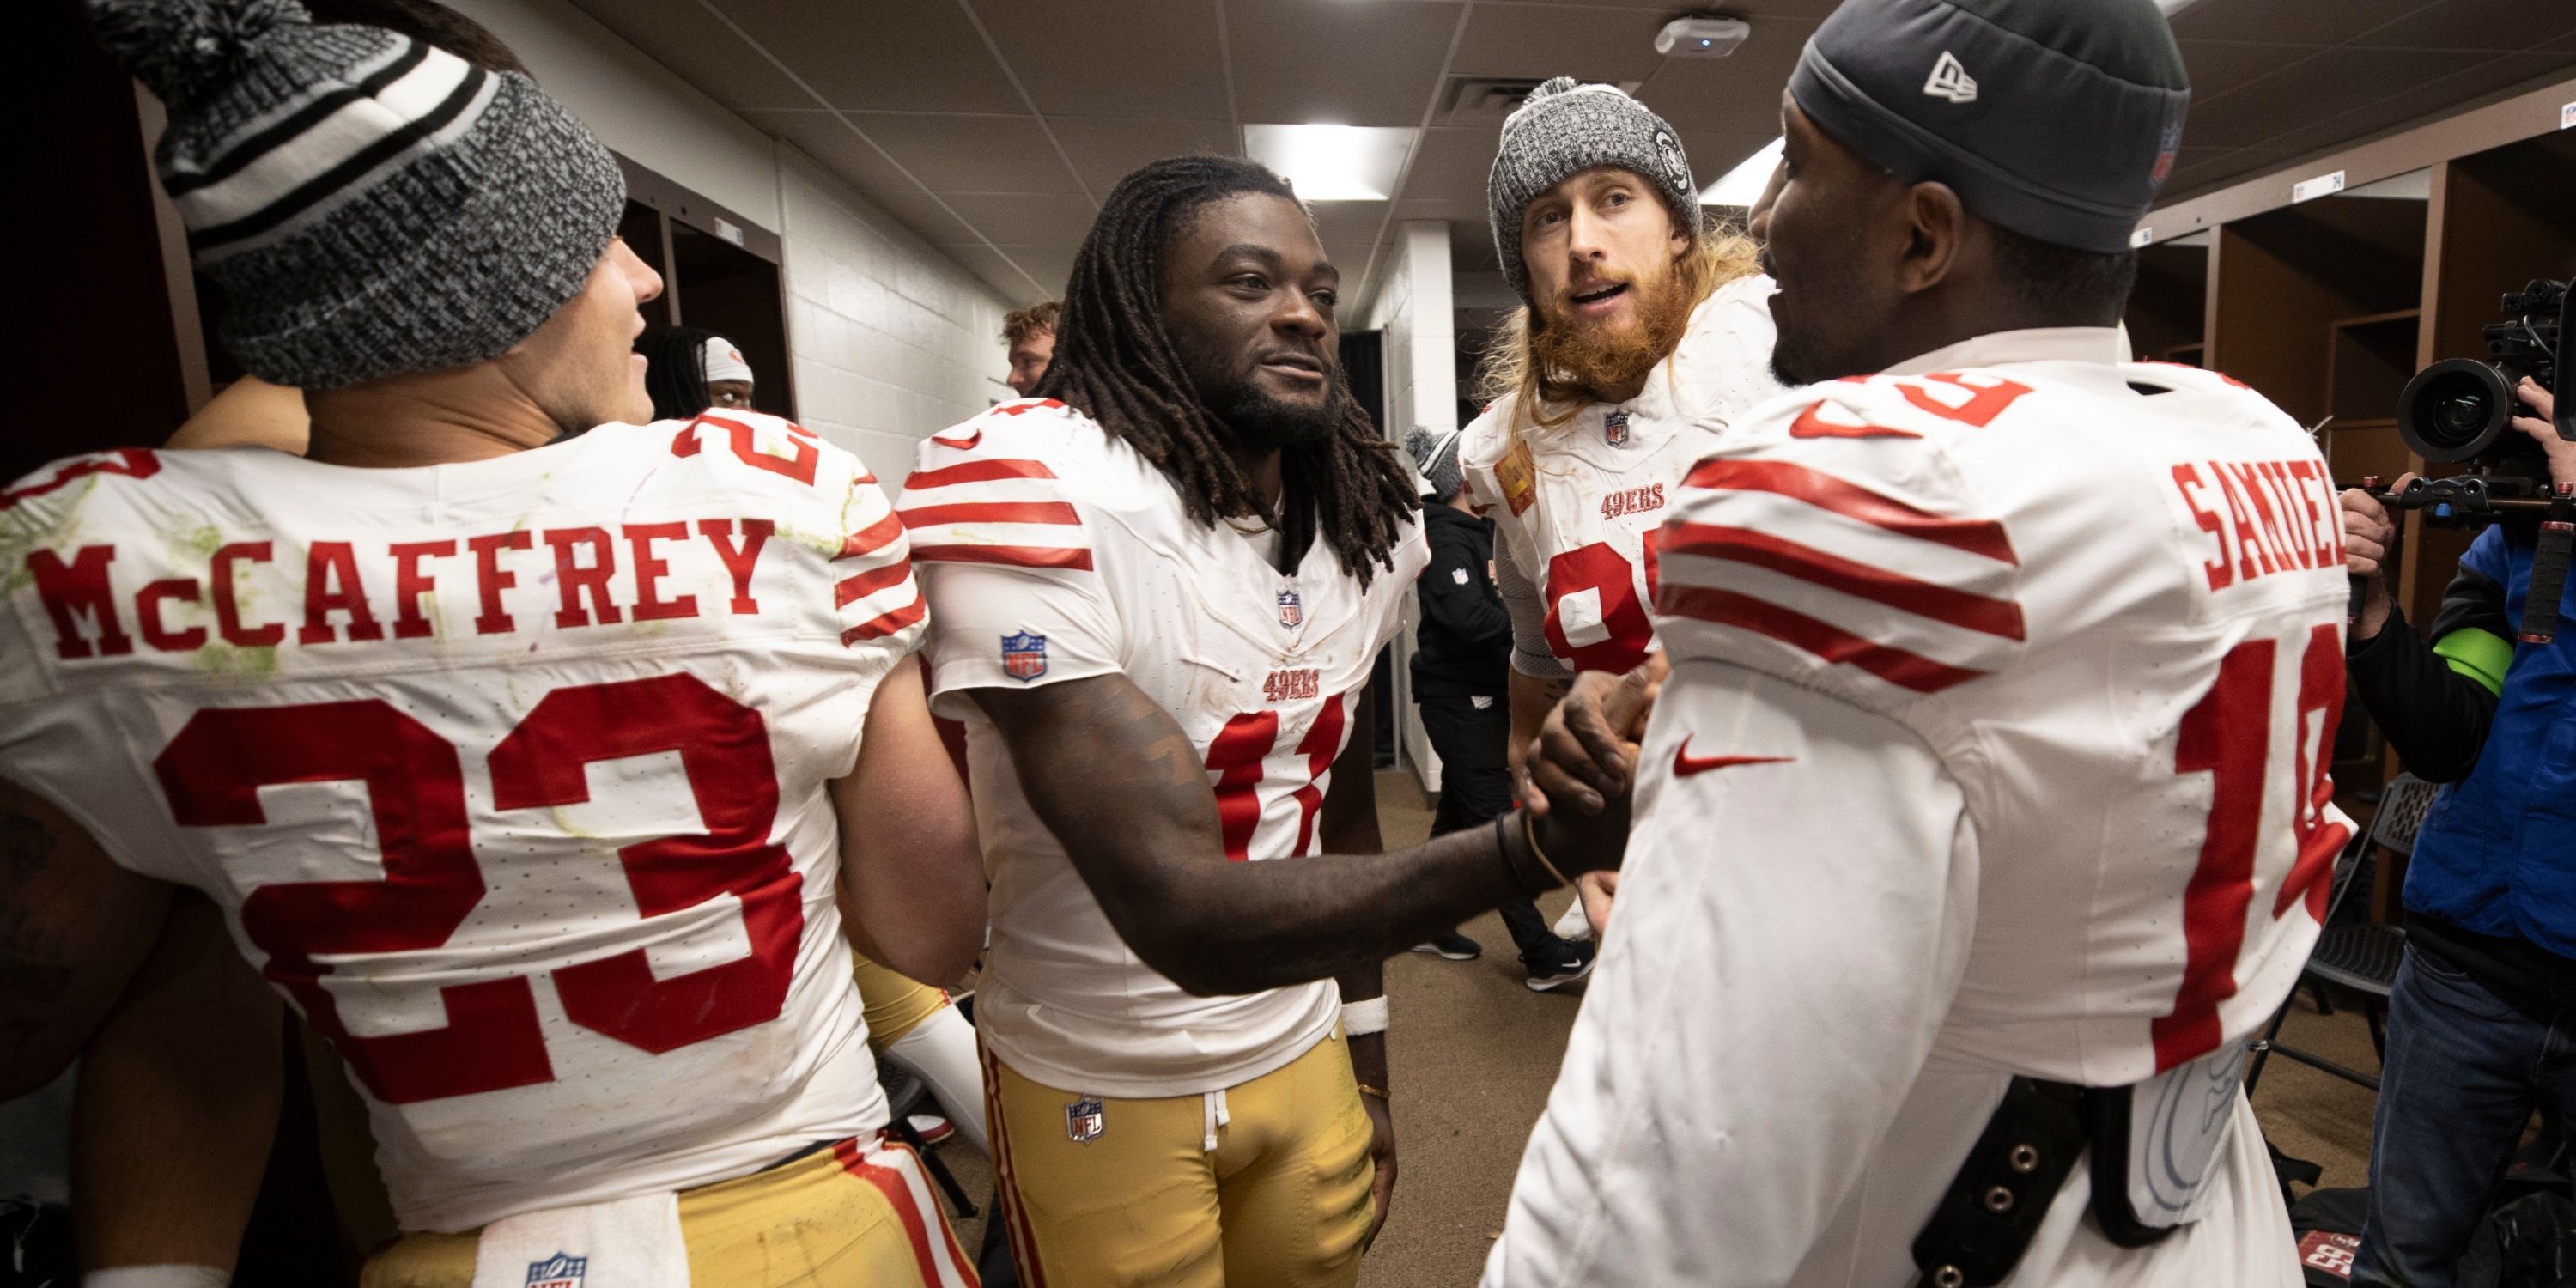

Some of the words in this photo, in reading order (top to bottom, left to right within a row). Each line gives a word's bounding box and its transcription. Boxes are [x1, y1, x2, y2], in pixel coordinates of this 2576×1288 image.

[1601, 482, 1665, 520] 49ERS
[2172, 459, 2348, 592] SAMUEL
[26, 519, 775, 659] McCAFFREY
[1545, 528, 1658, 677] 8
[1205, 691, 1346, 863] 11
[154, 671, 804, 1104] 23
